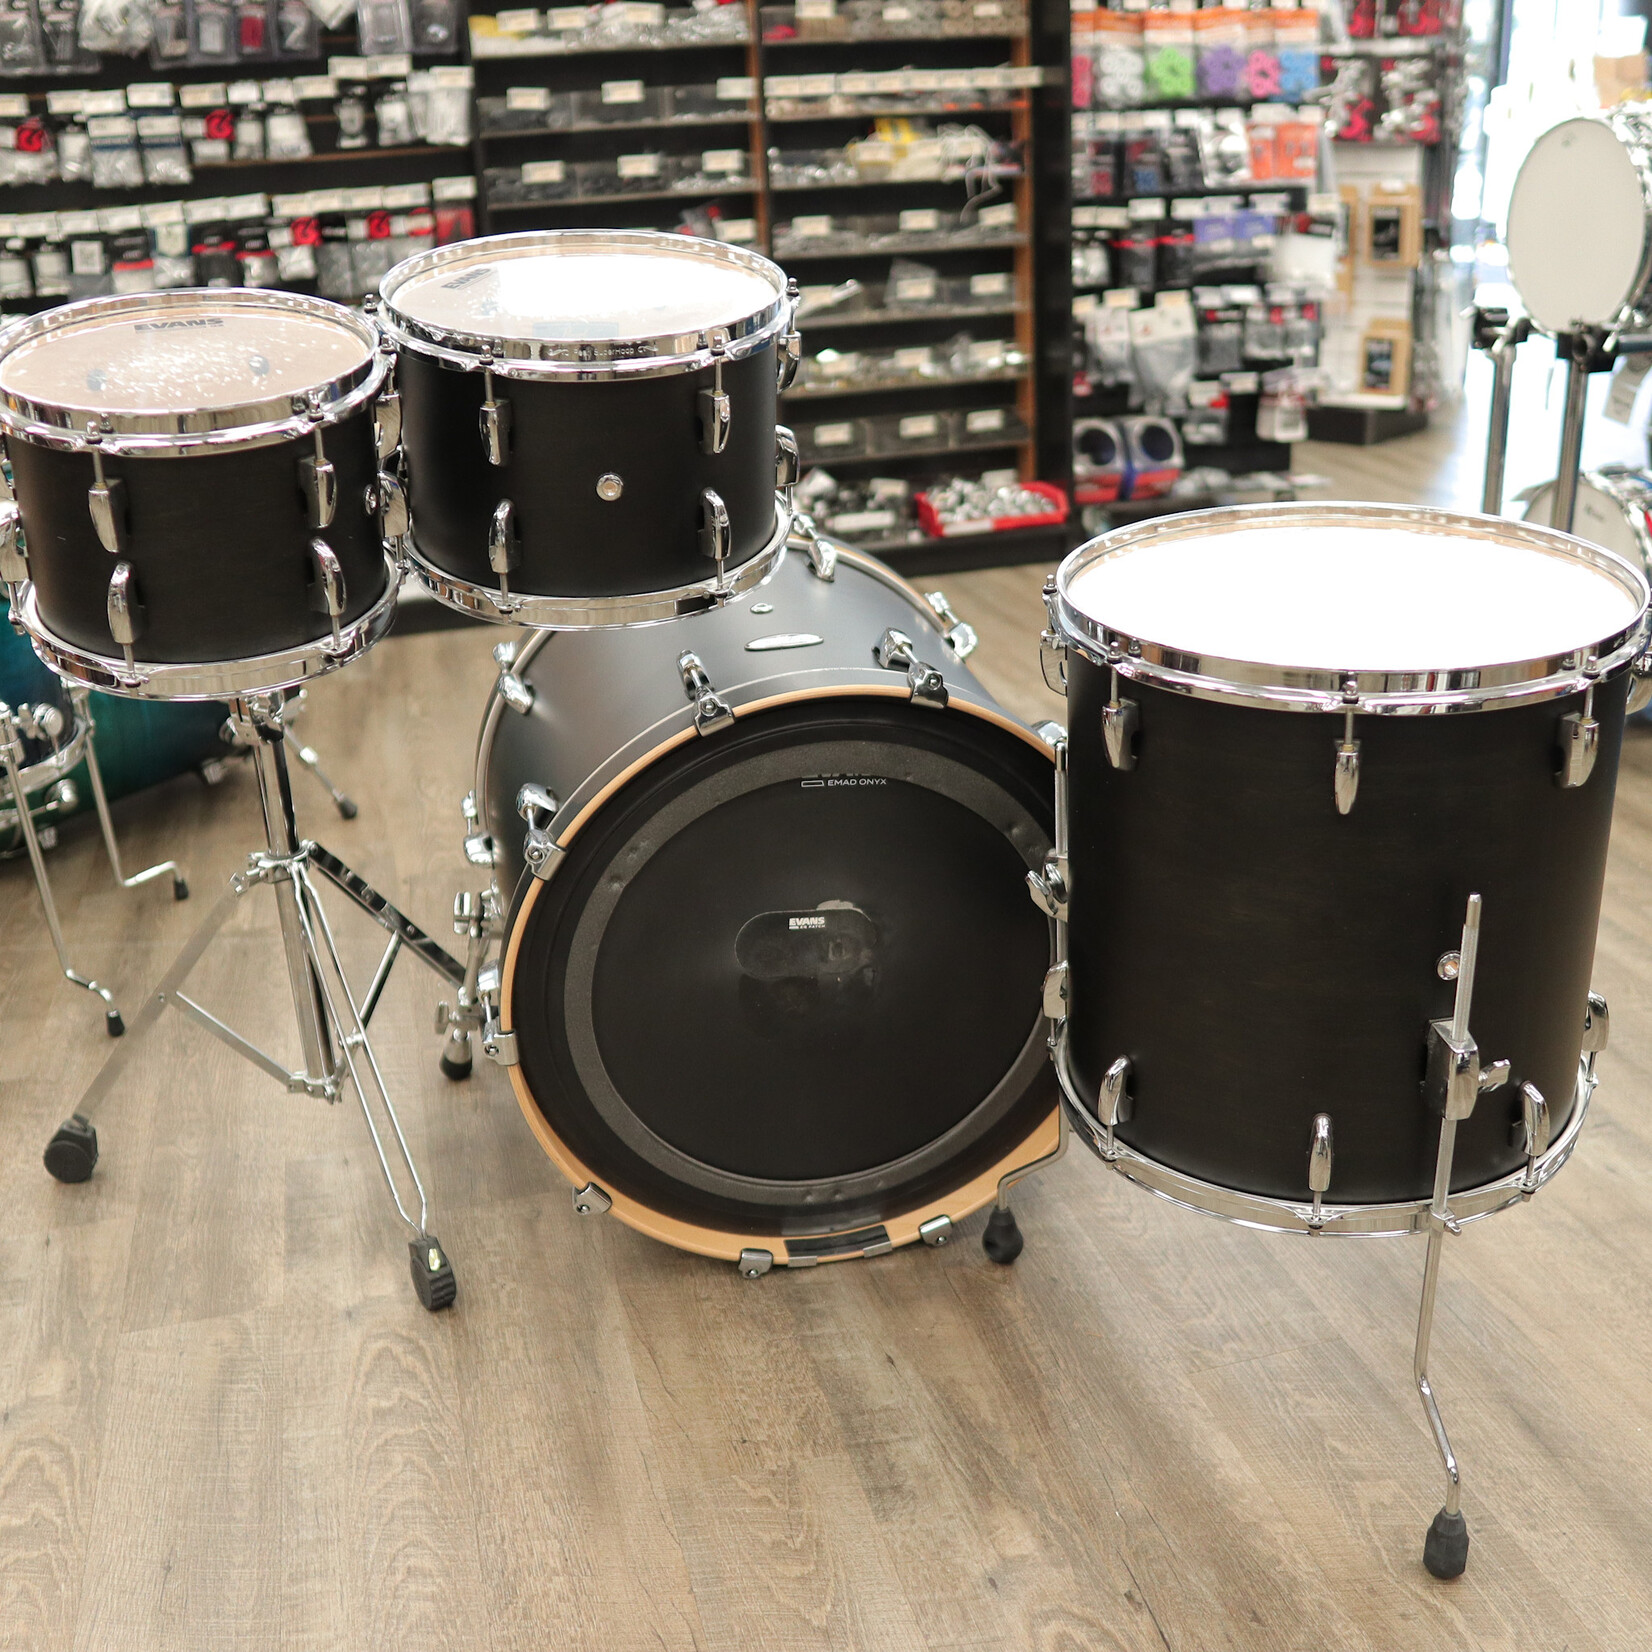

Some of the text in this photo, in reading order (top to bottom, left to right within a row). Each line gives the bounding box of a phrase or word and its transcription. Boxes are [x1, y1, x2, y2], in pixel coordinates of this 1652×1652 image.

[134, 317, 224, 331] EVANS
[827, 779, 857, 787] EMAD
[789, 916, 825, 925] EVANS
